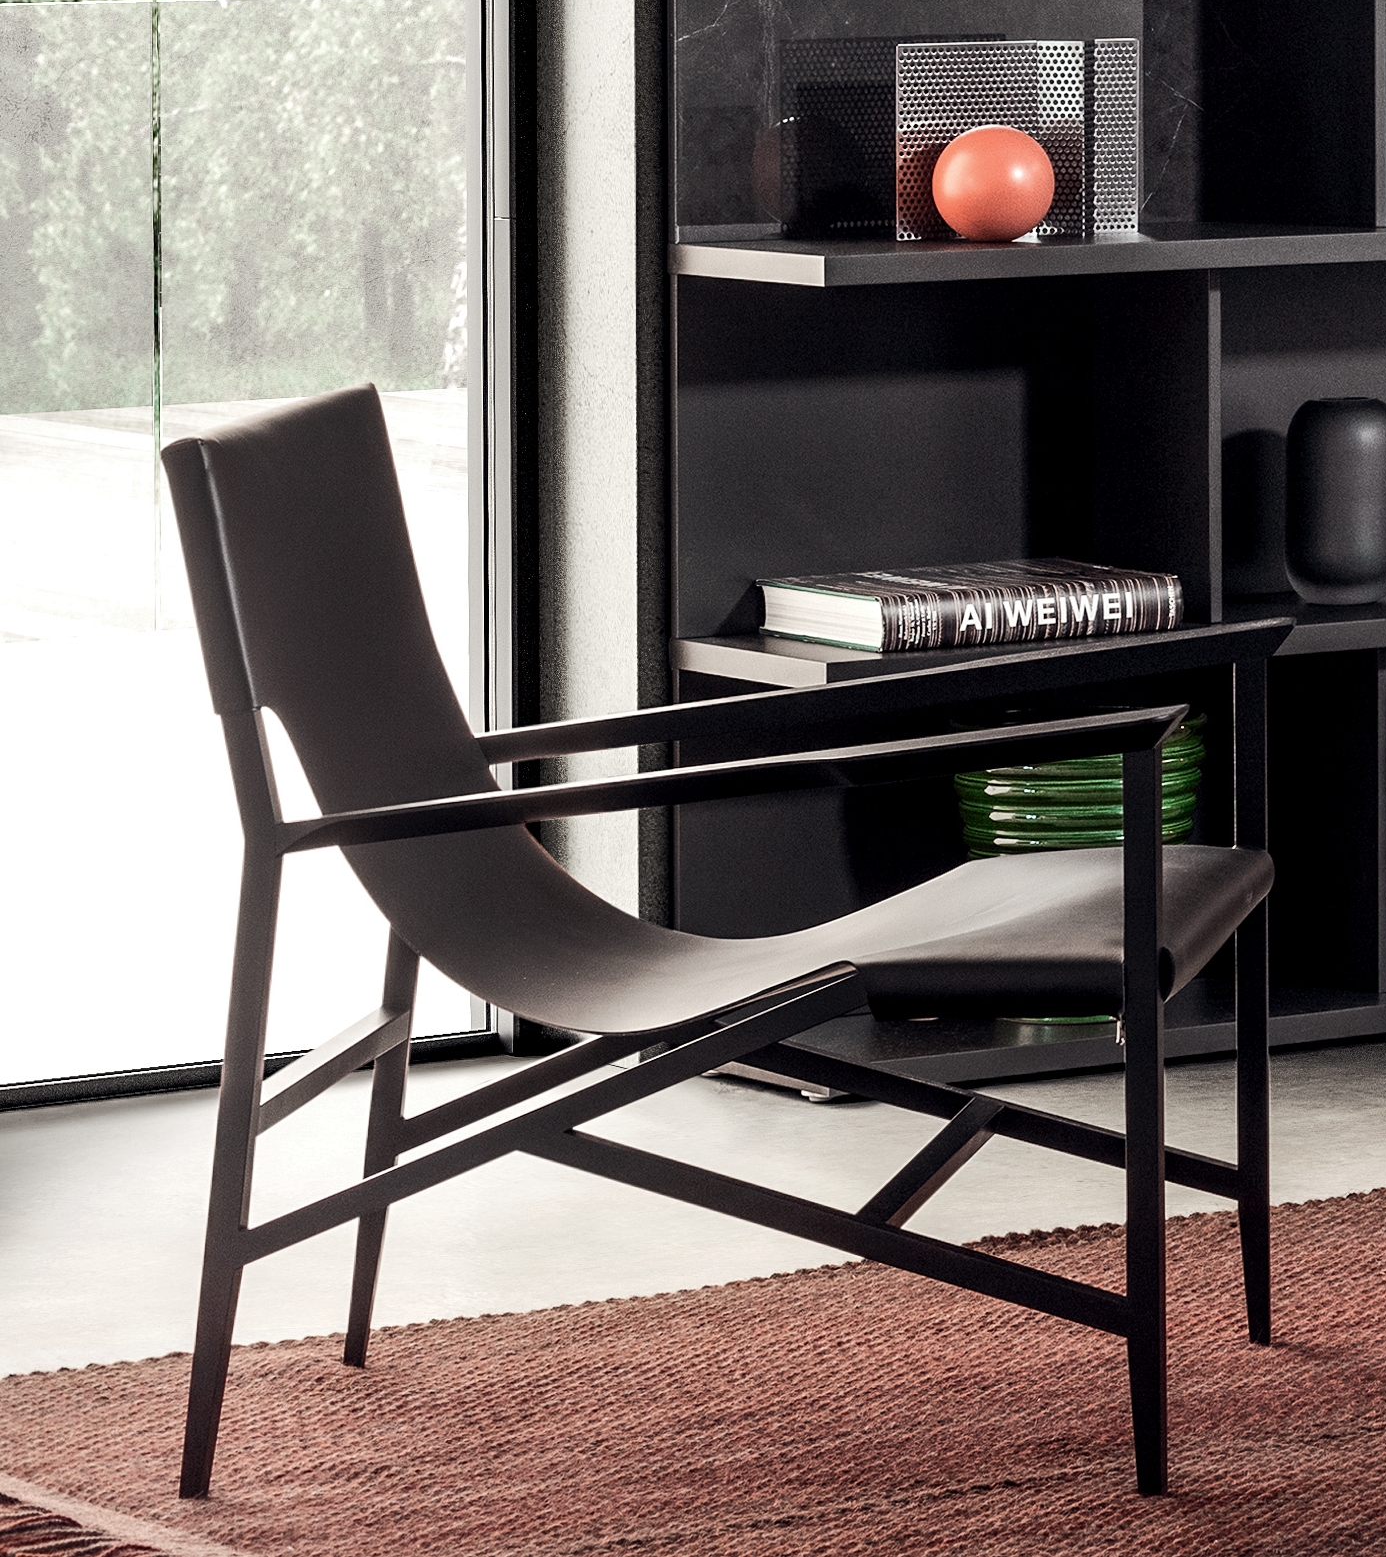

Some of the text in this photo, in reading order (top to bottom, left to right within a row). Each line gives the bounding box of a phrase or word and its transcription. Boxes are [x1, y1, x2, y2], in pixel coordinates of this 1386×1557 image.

[959, 601, 993, 632] AI
[1002, 590, 1134, 629] WEIWEI
[1168, 585, 1176, 619] TASCHEN
